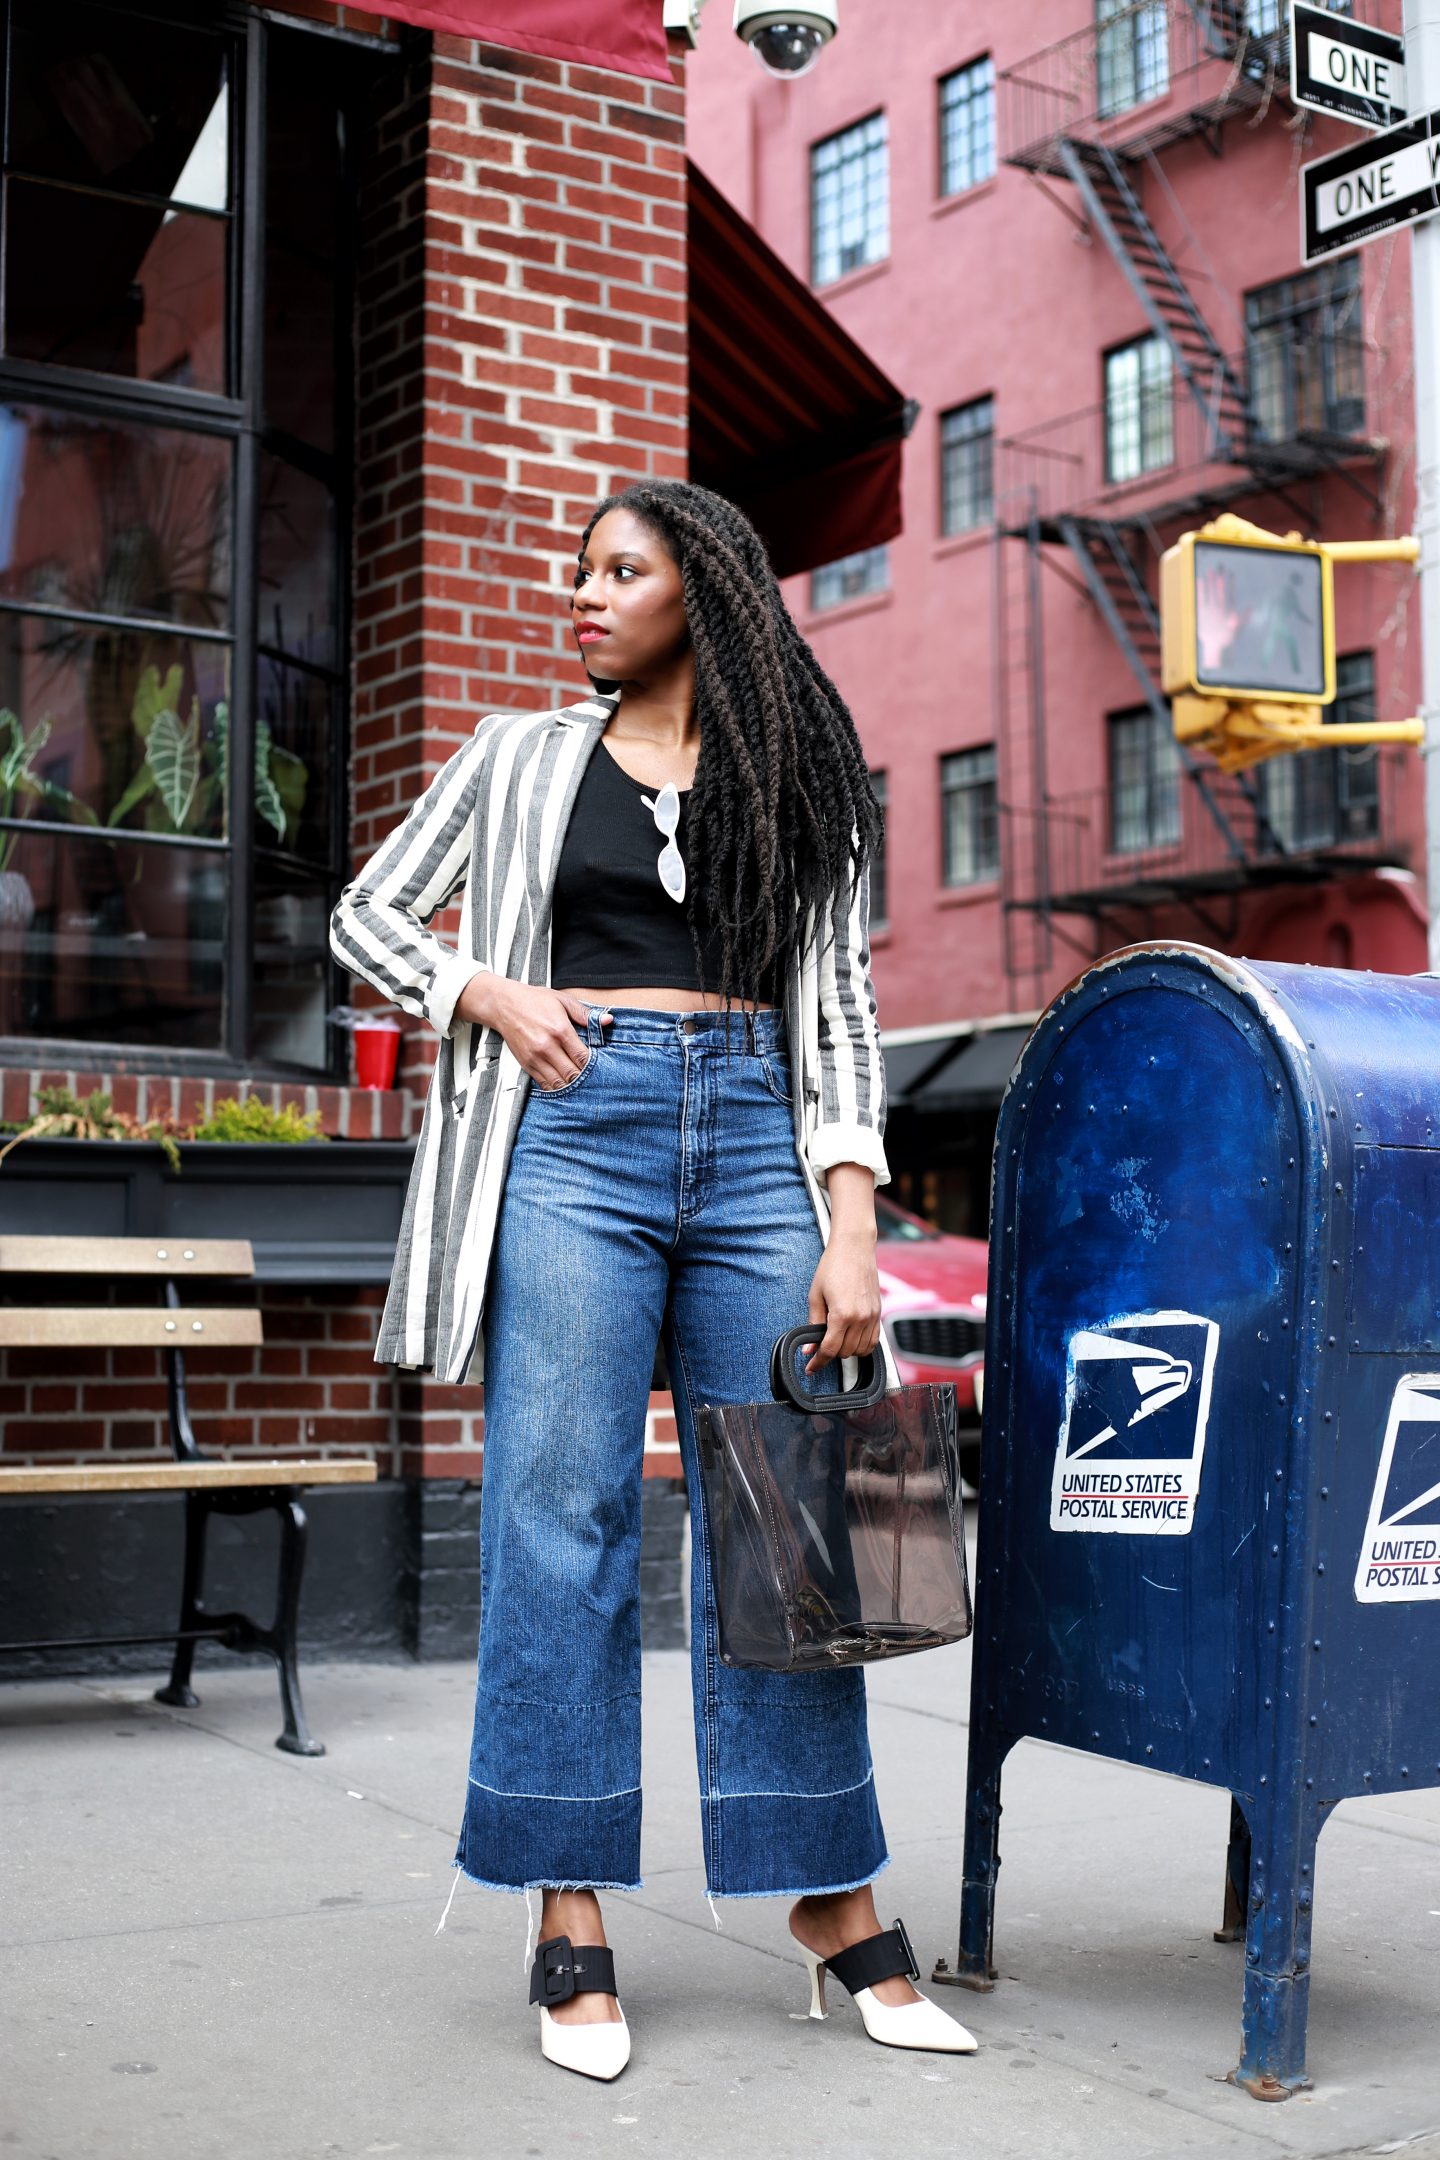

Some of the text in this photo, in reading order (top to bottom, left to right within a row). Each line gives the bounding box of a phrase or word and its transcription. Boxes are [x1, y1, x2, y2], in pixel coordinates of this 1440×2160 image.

[1328, 47, 1390, 99] ONE
[1335, 162, 1396, 217] ONE
[1062, 1474, 1183, 1493] UNITED STATES
[1059, 1499, 1188, 1519] POSTAL SERVICE
[1371, 1540, 1437, 1561] UNITED
[1365, 1566, 1429, 1588] POSTAL
